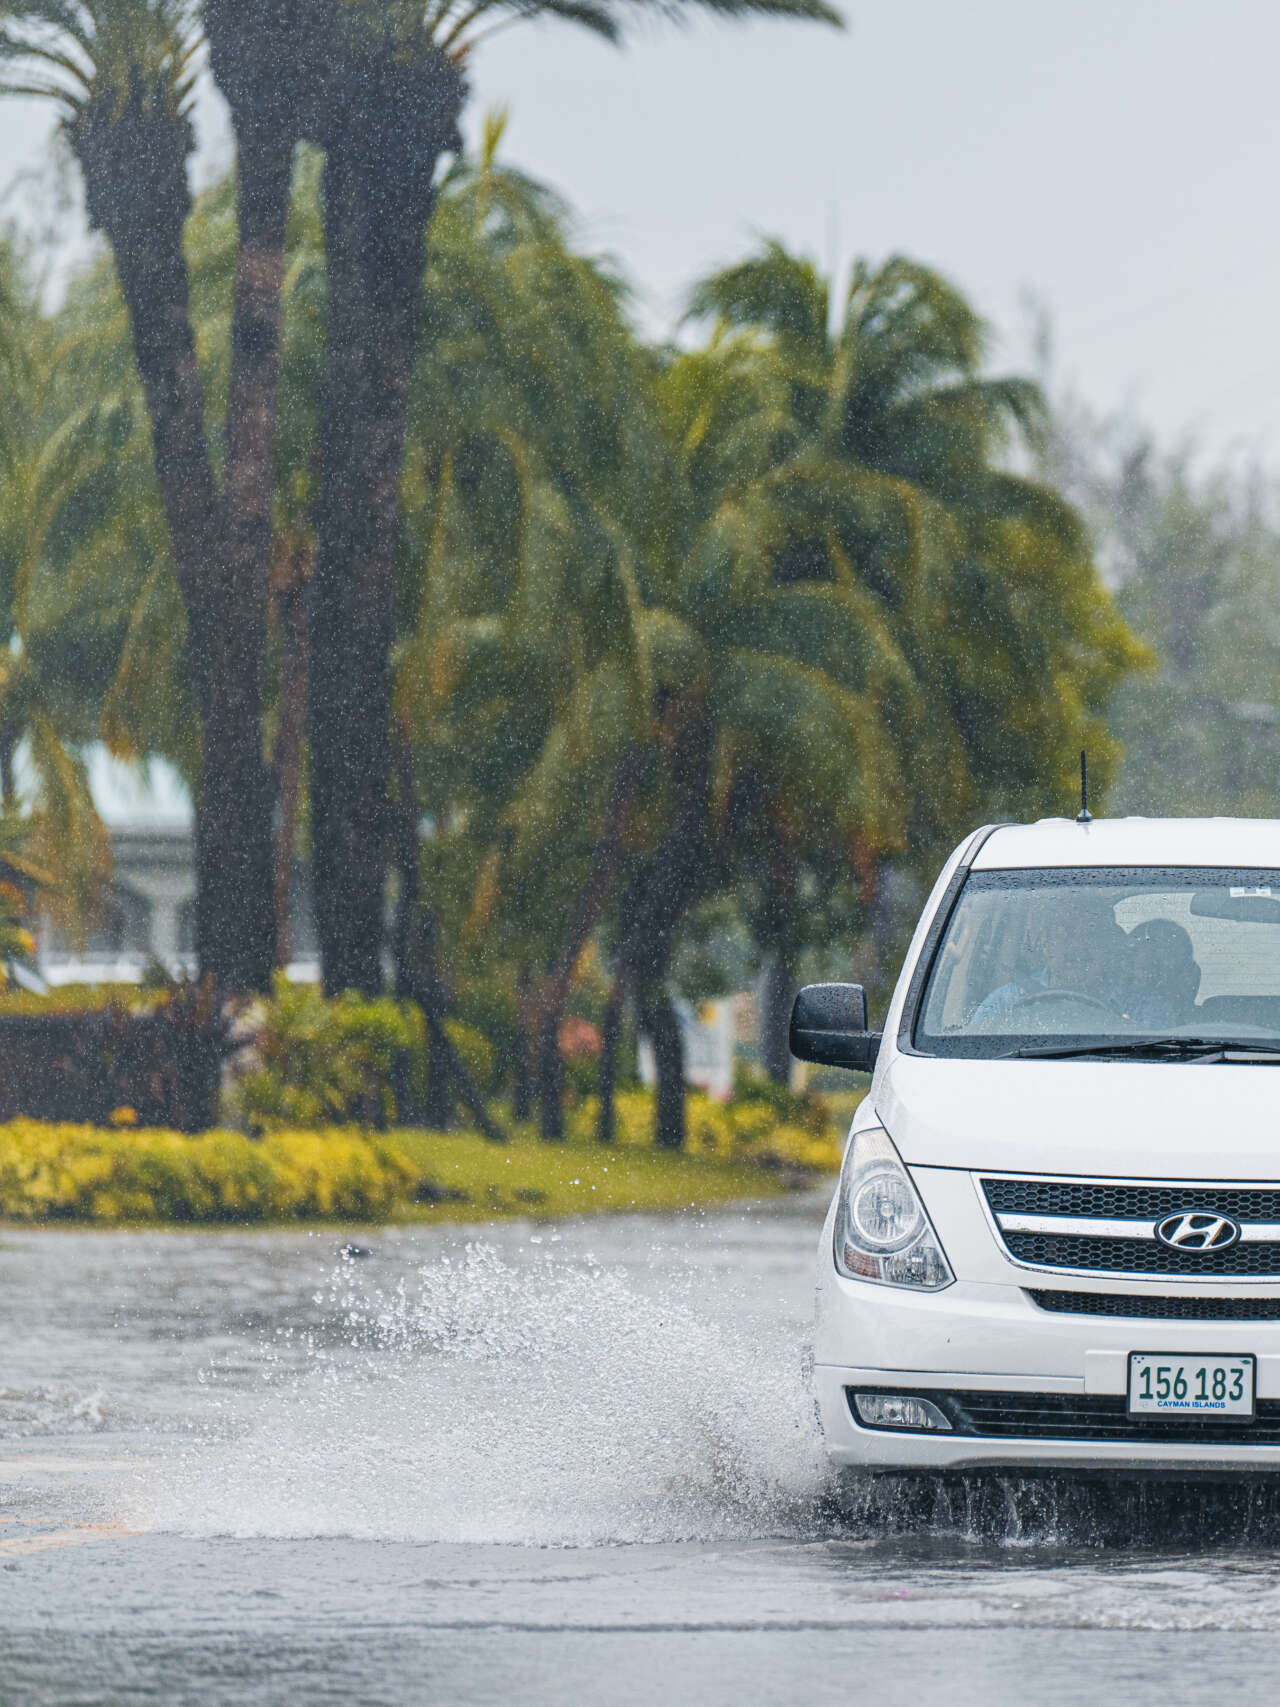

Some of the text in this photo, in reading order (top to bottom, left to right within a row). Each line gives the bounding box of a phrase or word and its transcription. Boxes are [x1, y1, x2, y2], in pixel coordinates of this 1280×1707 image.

[1139, 1366, 1244, 1401] 156 183
[1192, 1401, 1226, 1409] ISLANDS
